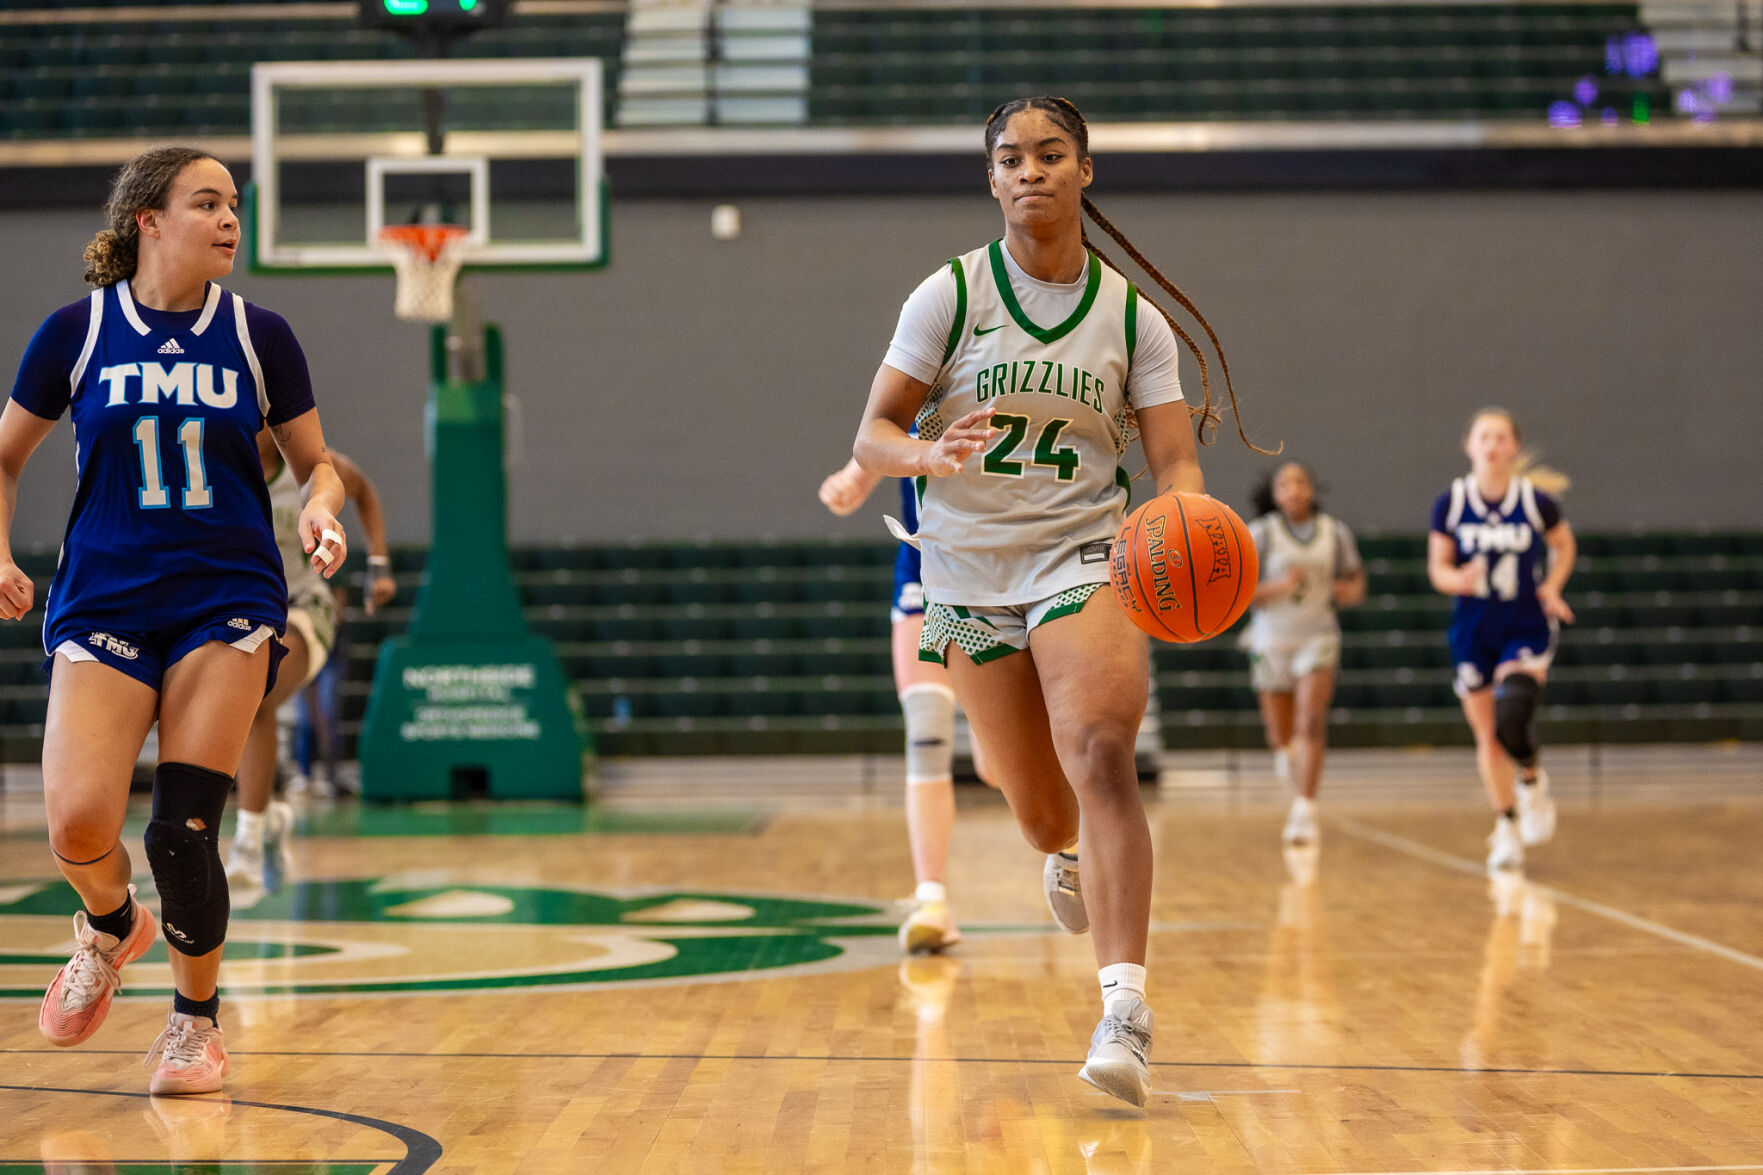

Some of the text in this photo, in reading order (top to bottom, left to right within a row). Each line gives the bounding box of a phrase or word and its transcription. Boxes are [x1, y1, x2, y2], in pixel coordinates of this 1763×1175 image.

[99, 362, 239, 409] TMU
[976, 360, 1105, 414] GRIZZLIES
[132, 416, 213, 509] 11
[981, 412, 1081, 483] 24
[1116, 526, 1143, 613] LEGACY
[1145, 514, 1183, 612] SPALDING
[1195, 516, 1232, 586] NAIA
[1457, 522, 1533, 553] TMU
[88, 631, 140, 660] TMU
